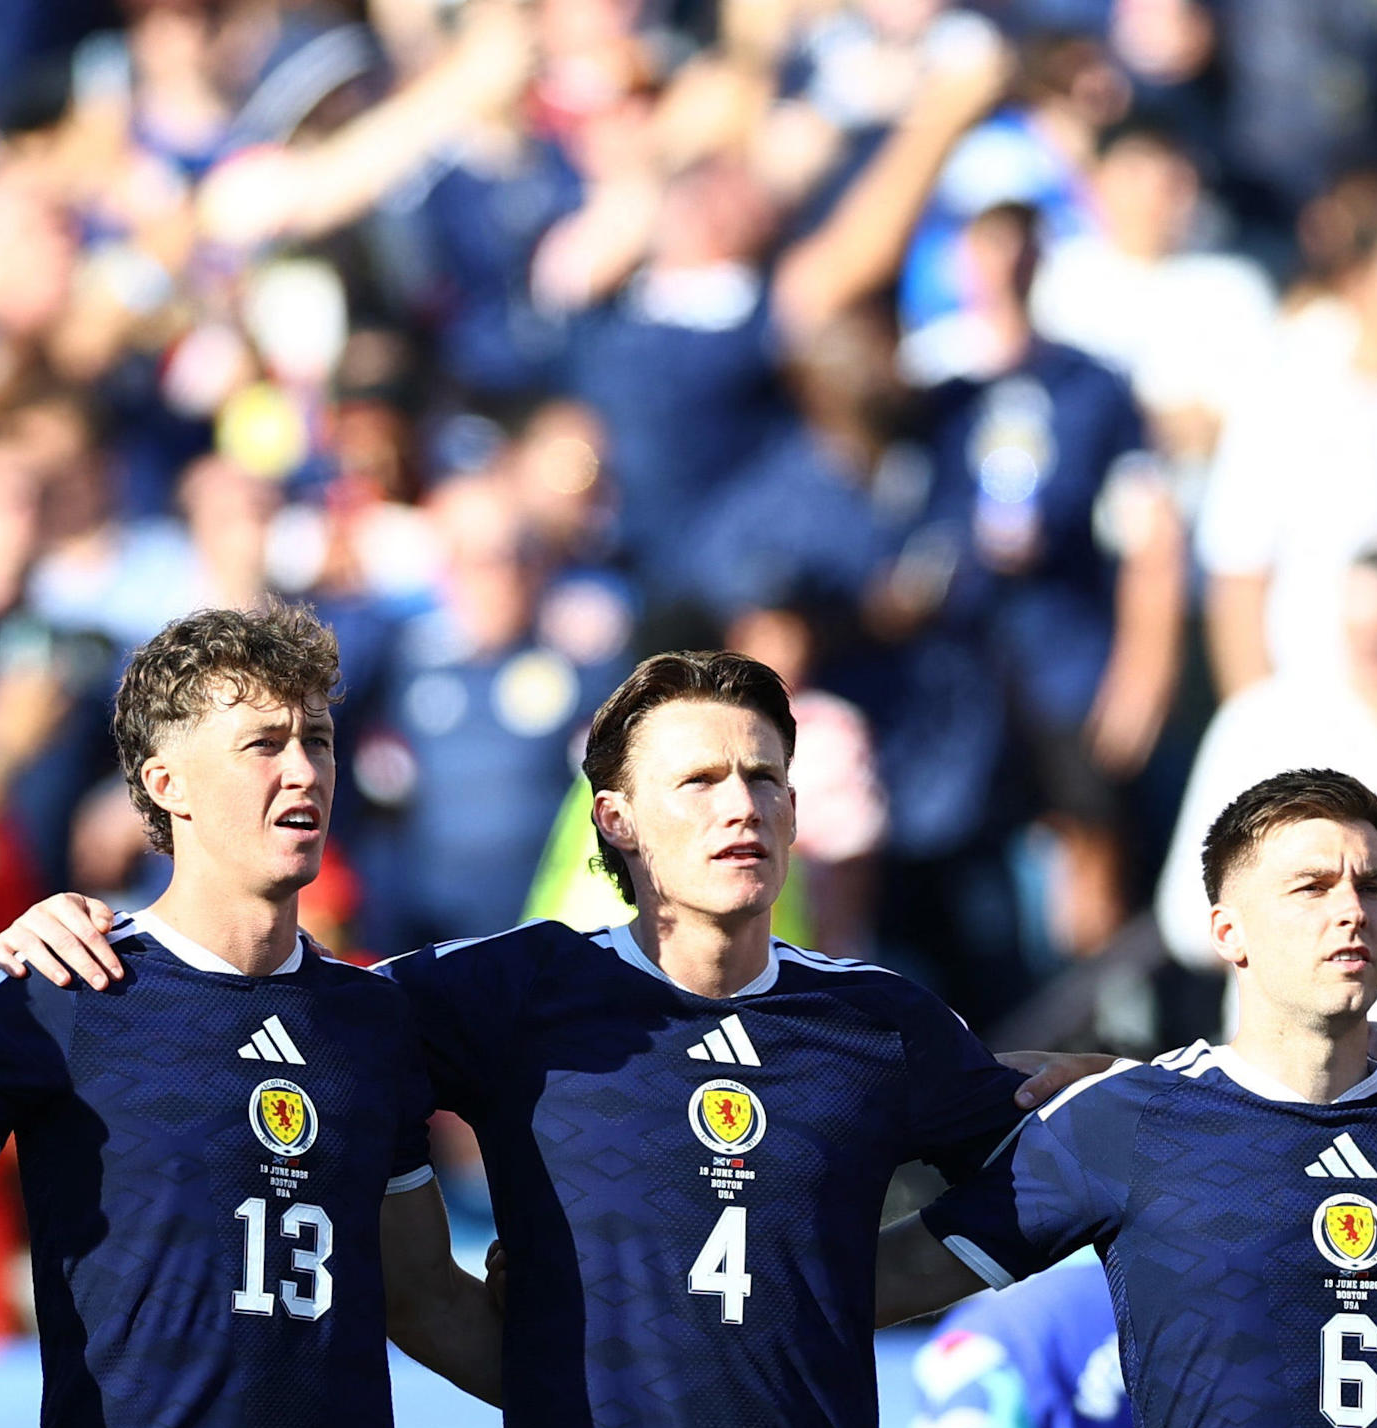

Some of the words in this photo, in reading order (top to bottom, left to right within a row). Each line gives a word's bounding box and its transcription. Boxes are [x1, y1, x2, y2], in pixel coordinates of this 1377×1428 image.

[270, 1166, 290, 1176] JUNE
[699, 1166, 709, 1176] 19
[710, 1167, 733, 1178] JUNE
[734, 1169, 755, 1180] 2026
[270, 1176, 298, 1189] BOSTON
[711, 1179, 743, 1190] BOSTON
[275, 1187, 290, 1198] USA
[718, 1190, 735, 1200] USA
[232, 1197, 333, 1320] 13
[688, 1206, 751, 1325] 4
[1324, 1279, 1333, 1288] 19
[1335, 1279, 1358, 1289] JUNE
[1336, 1290, 1368, 1300] BOSTON
[1343, 1301, 1359, 1310] USA
